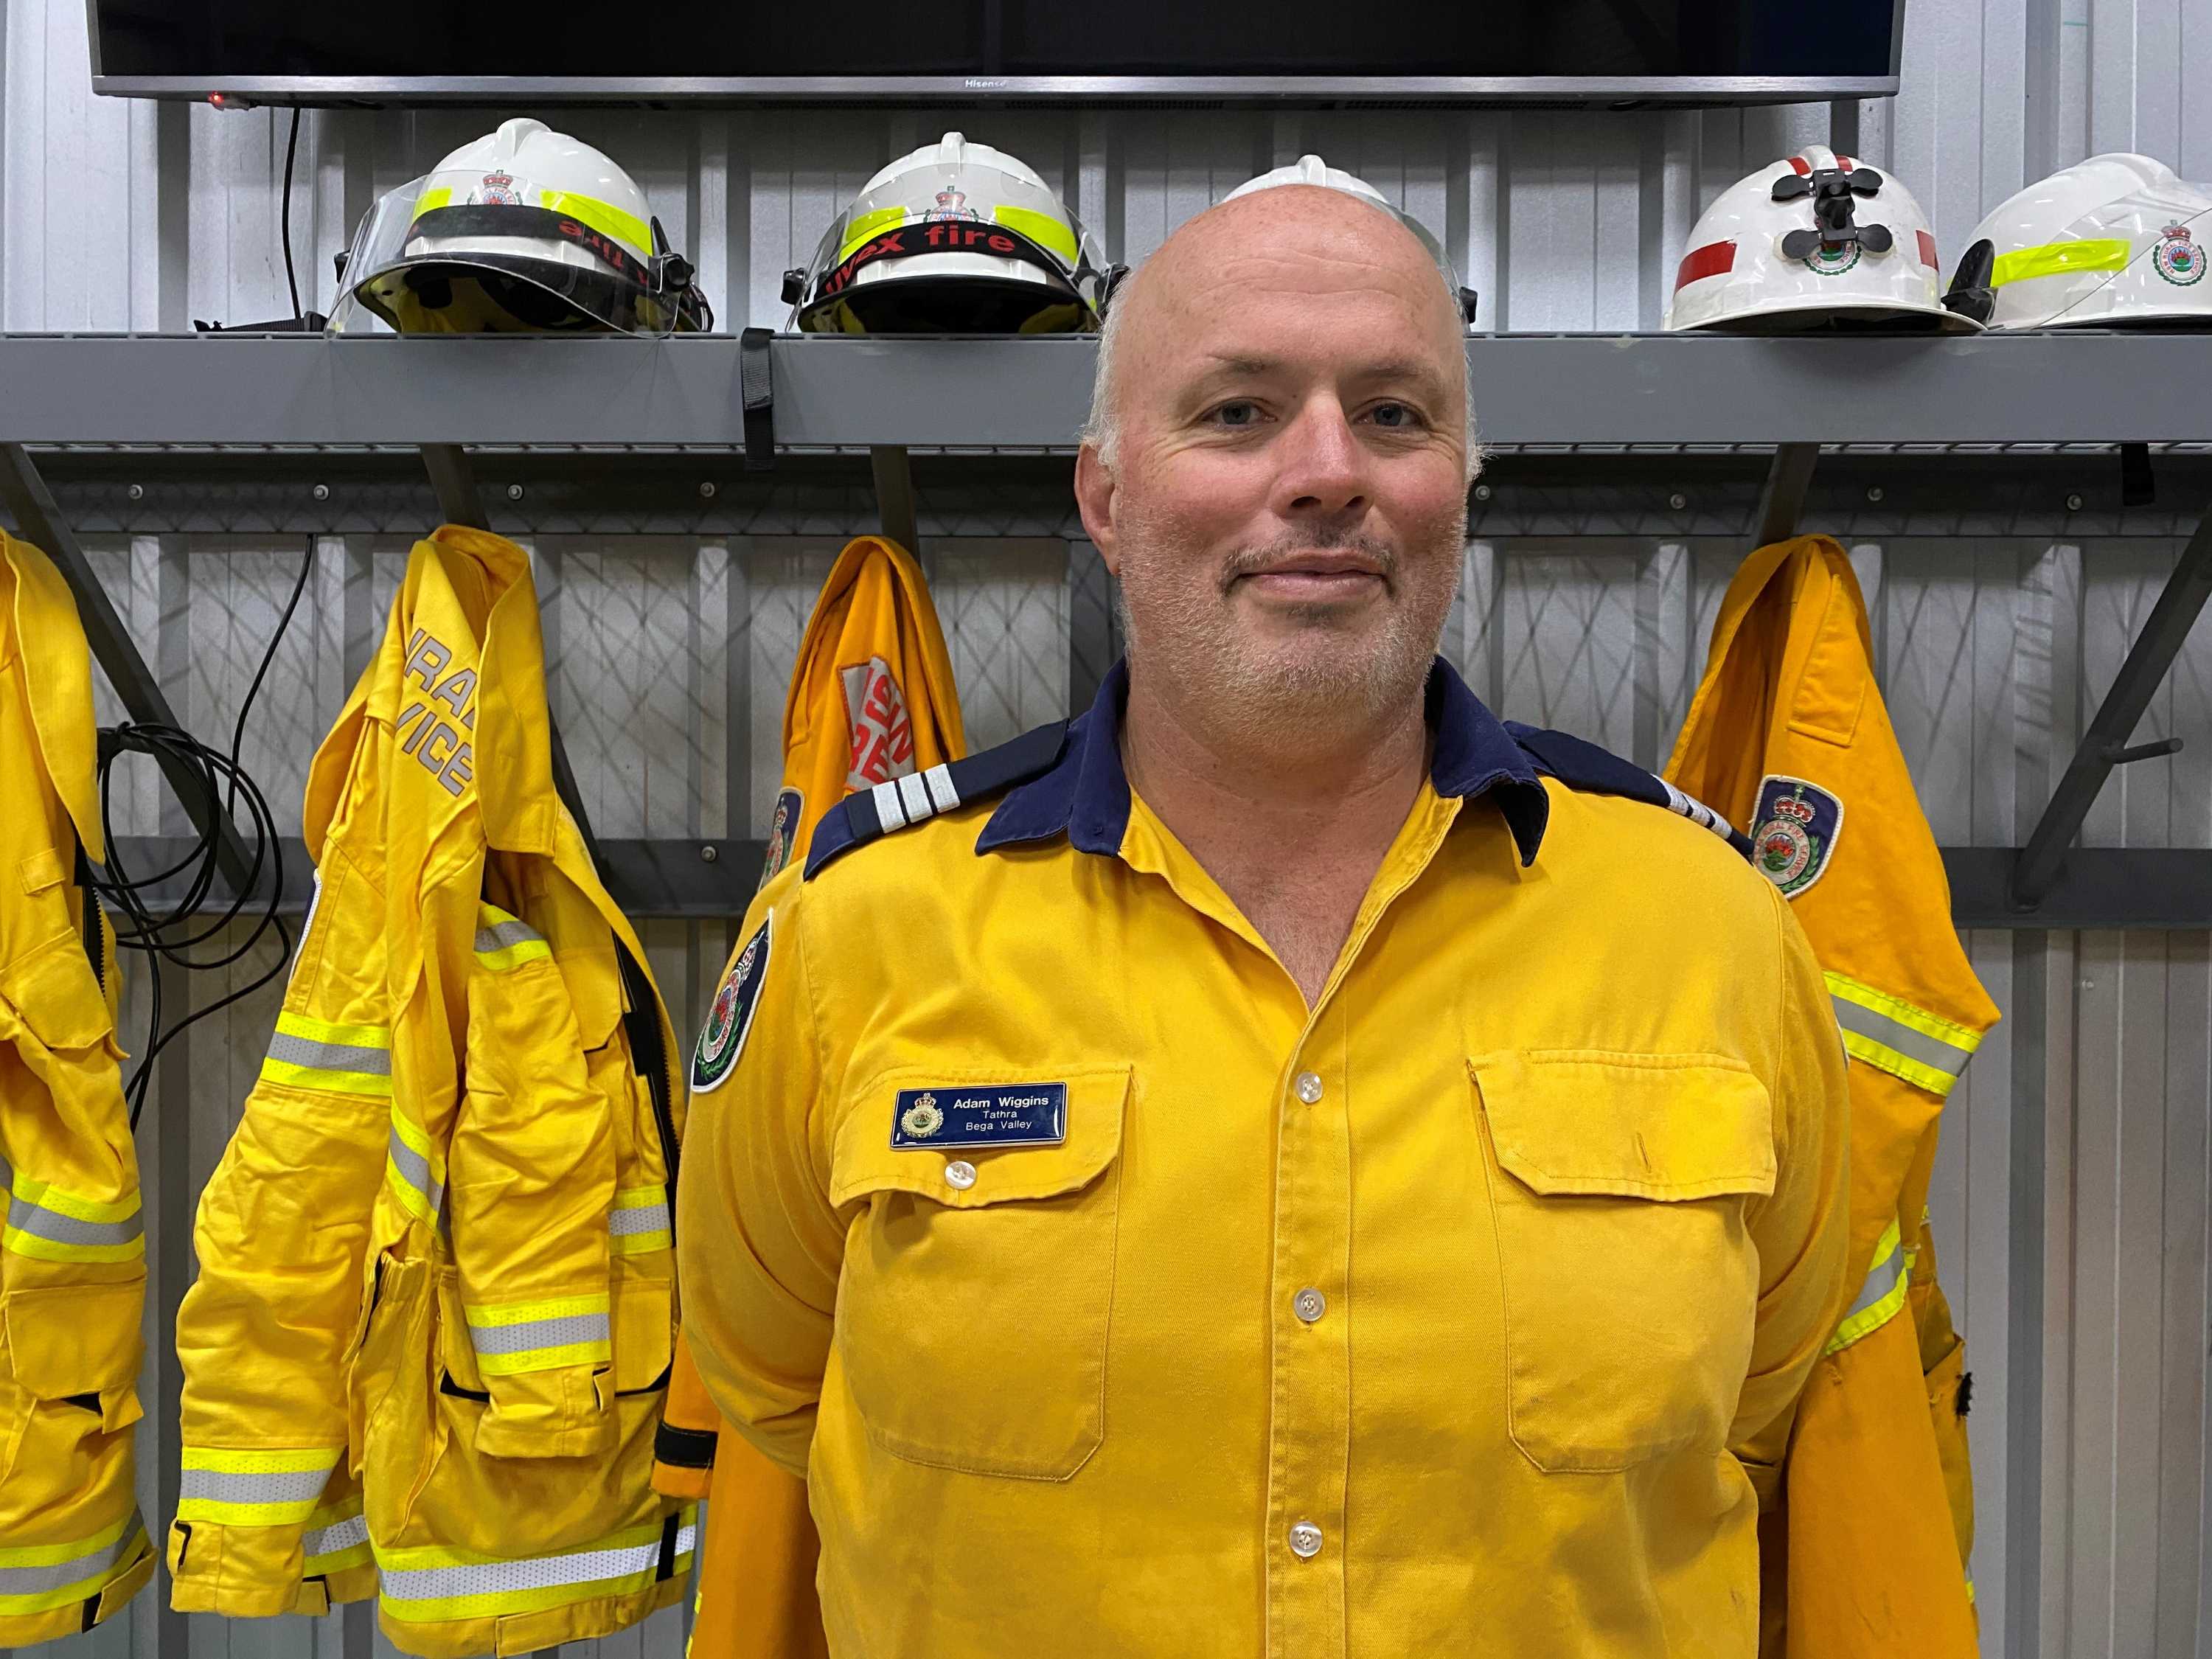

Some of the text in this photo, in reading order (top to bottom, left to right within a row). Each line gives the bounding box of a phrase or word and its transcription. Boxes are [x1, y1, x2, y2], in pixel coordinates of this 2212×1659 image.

[824, 224, 1016, 295] uvex fire
[953, 1096, 1048, 1109] Adam Wiggins
[983, 1110, 1018, 1119] Tathra
[966, 1120, 1032, 1131] Bega Valley
